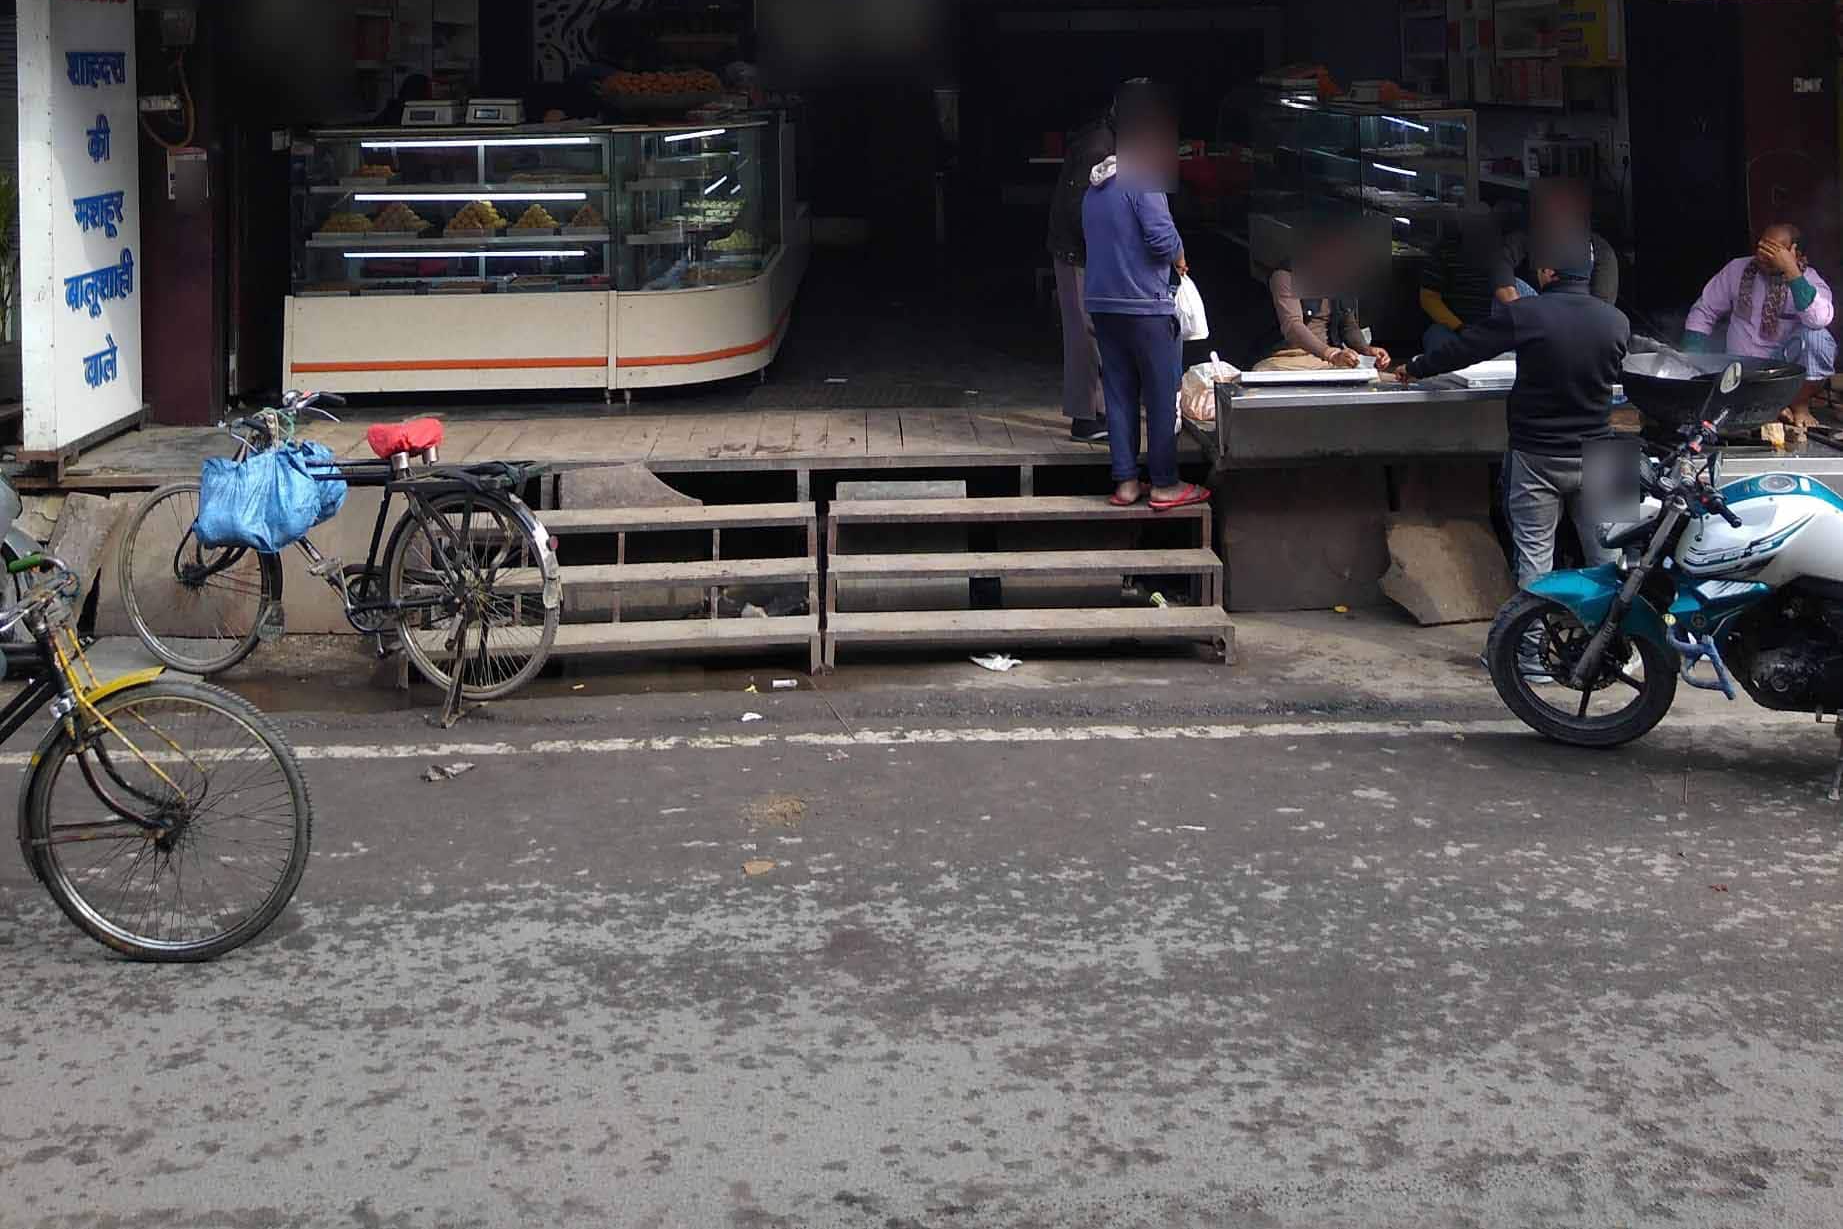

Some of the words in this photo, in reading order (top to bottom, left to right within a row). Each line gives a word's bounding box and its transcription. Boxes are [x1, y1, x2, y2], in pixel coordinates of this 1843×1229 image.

[86, 113, 111, 163] की
[73, 190, 124, 238] मशहूर
[64, 248, 134, 318] बालूशाही
